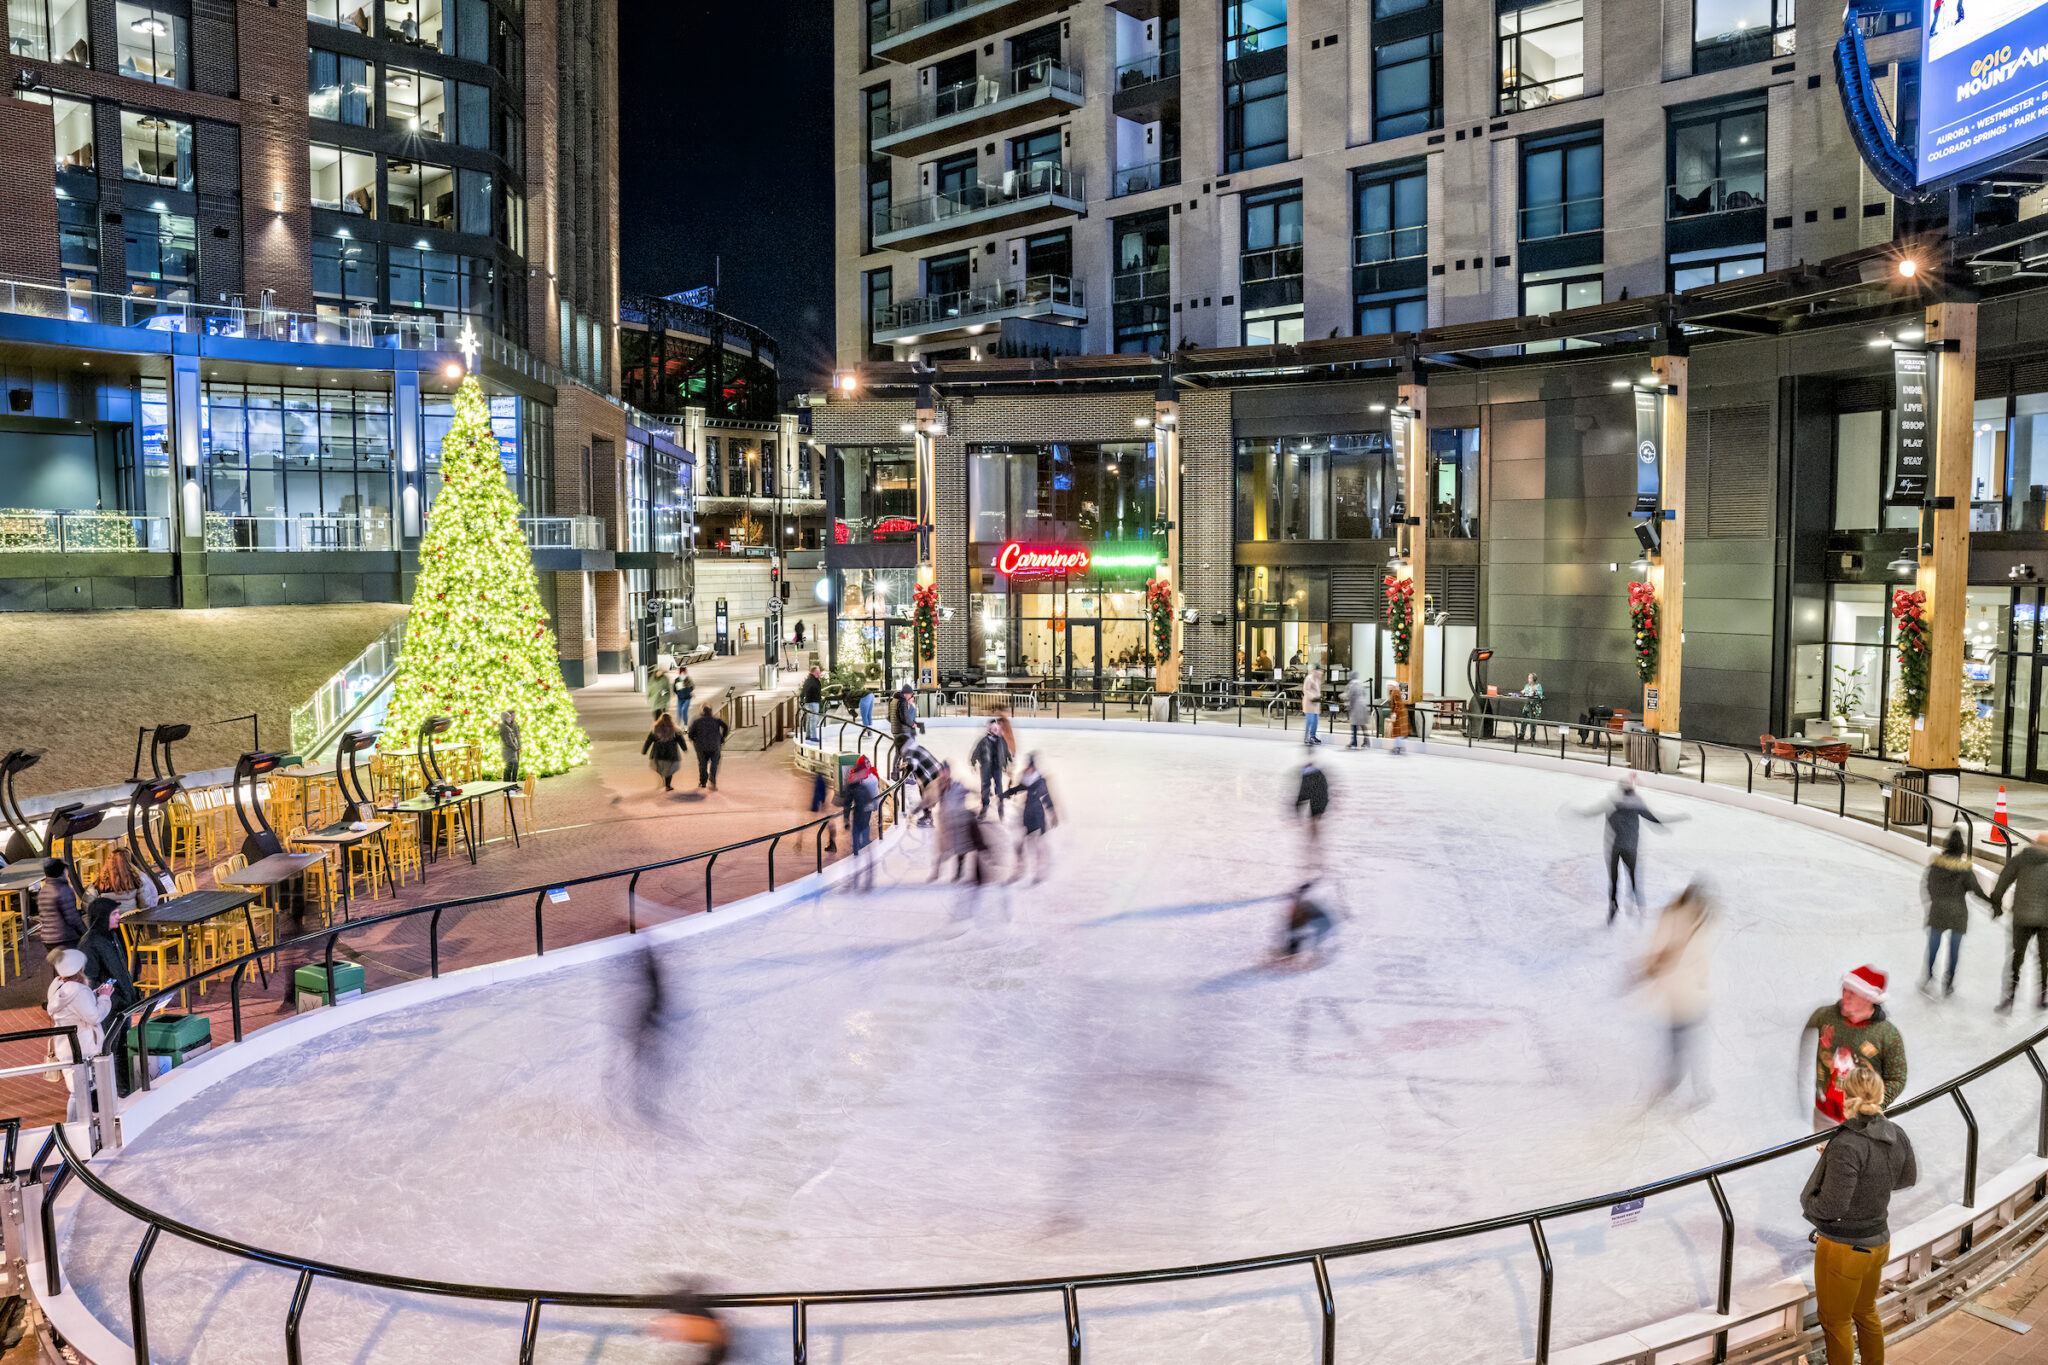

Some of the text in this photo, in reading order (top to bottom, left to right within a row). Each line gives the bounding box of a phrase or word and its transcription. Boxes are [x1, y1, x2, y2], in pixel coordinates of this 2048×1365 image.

[1956, 43, 2048, 102] MOUNTAIN
[1970, 45, 2012, 80] epic
[1936, 125, 1970, 146] AURORA
[1976, 97, 2034, 129] WESTMINSTER
[1927, 139, 1972, 162] COLORADO
[1973, 124, 2007, 145] SPRINGS
[2014, 110, 2037, 128] PARK
[1902, 385, 1923, 395] DINE
[1903, 403, 1923, 413] LIVE
[1901, 420, 1925, 430] SHOP
[1902, 438, 1924, 448] PLAY
[1902, 456, 1923, 465] STAY
[999, 542, 1090, 574] Carmine's
